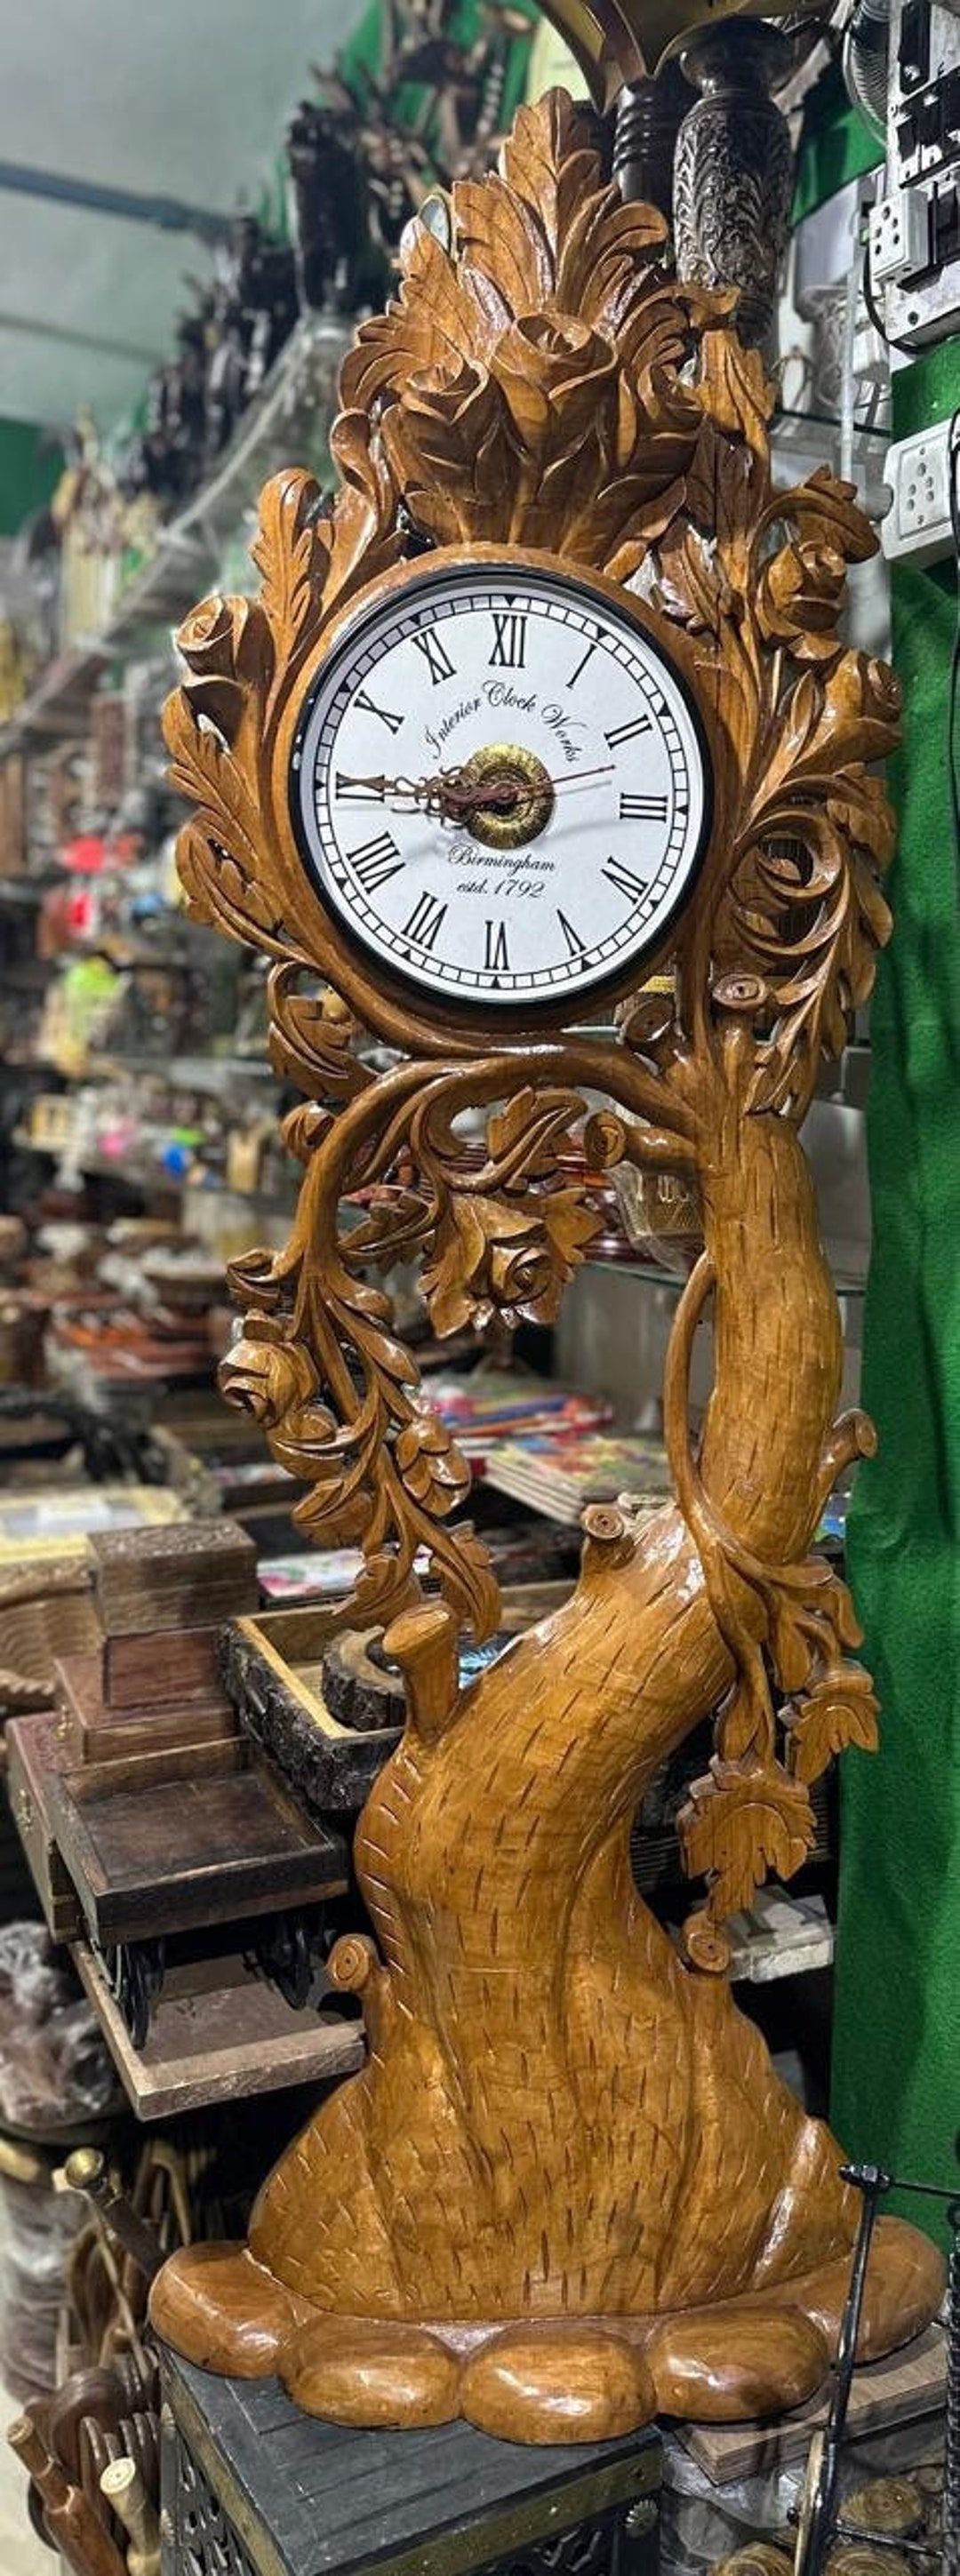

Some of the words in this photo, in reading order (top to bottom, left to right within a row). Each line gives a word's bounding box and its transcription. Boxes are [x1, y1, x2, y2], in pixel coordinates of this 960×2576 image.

[411, 628, 457, 685] XI
[490, 613, 528, 668] XII
[565, 644, 597, 689] I
[355, 691, 404, 734] X
[422, 698, 482, 759] Interior
[483, 680, 536, 713] Clock
[541, 703, 587, 763] Works
[604, 714, 652, 749] II
[620, 792, 668, 822] III
[347, 831, 406, 894] VIII
[448, 844, 556, 877] Birmingham
[601, 856, 649, 905] IV
[456, 878, 488, 894] estd.
[493, 879, 546, 899] 1792
[401, 892, 448, 950] VII
[556, 908, 587, 956] V
[484, 921, 509, 971] VI
